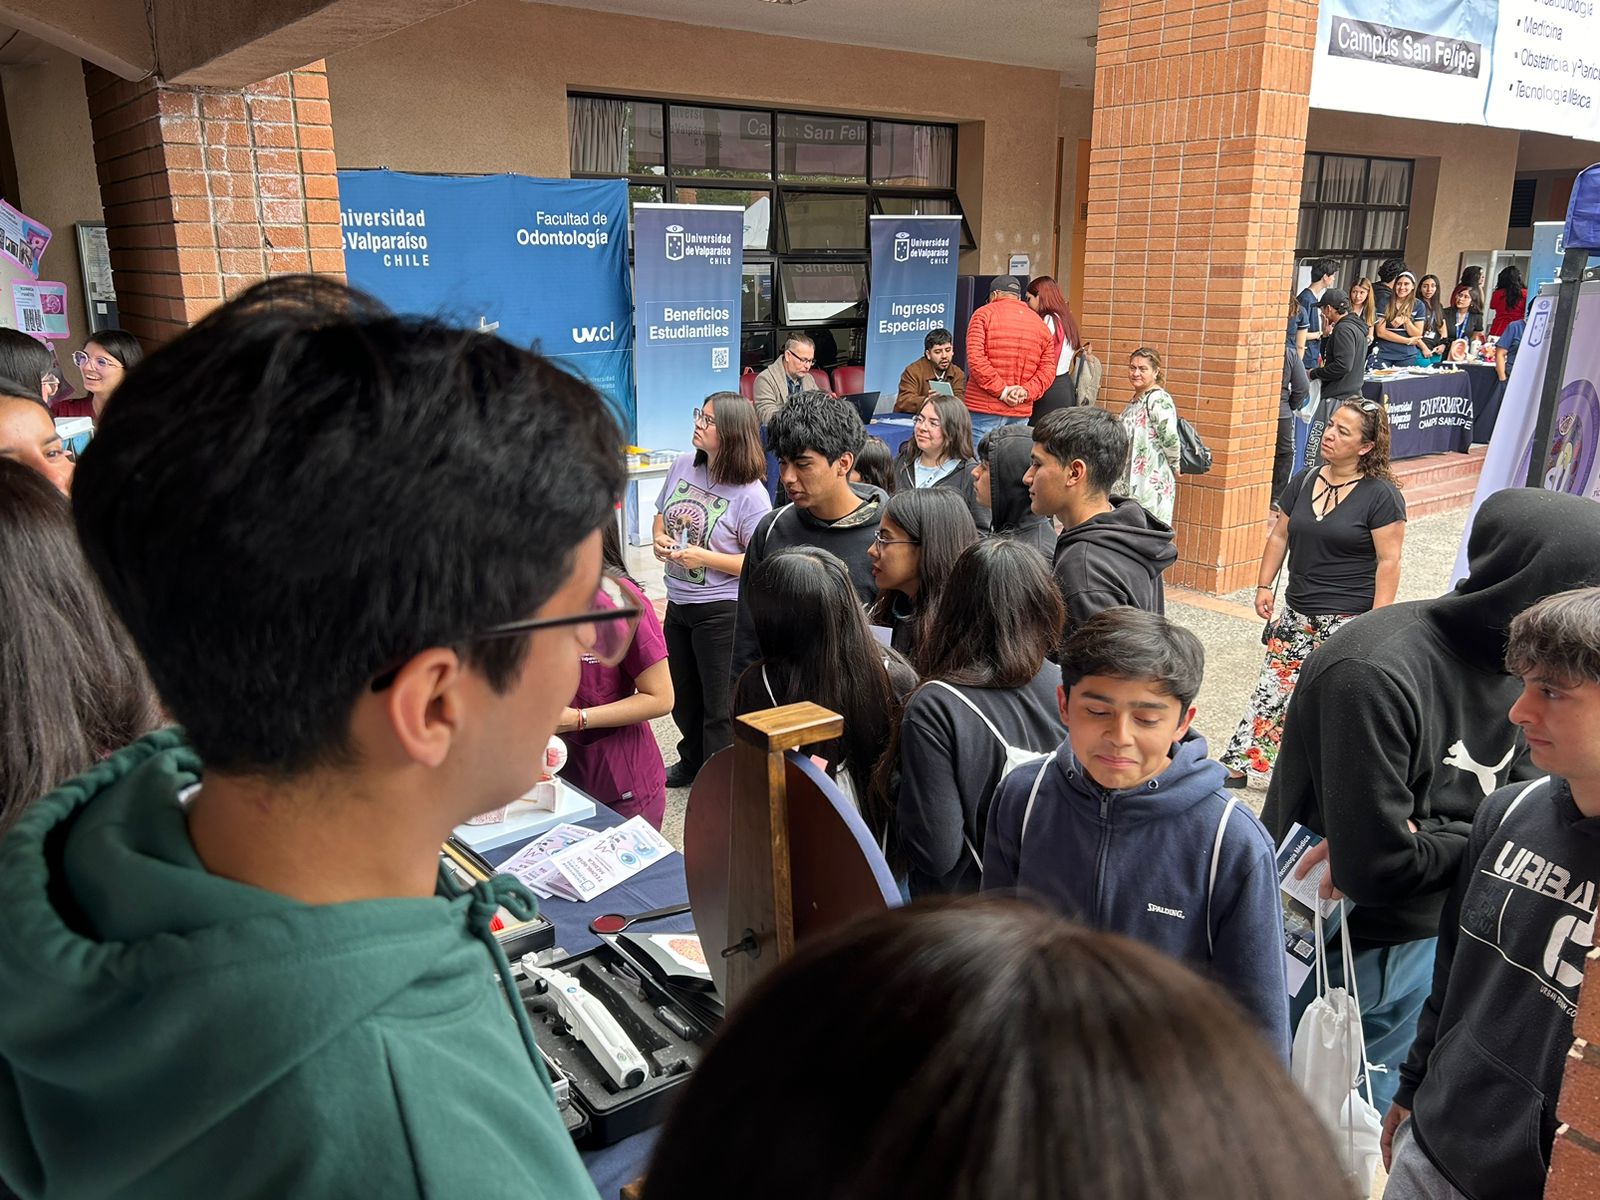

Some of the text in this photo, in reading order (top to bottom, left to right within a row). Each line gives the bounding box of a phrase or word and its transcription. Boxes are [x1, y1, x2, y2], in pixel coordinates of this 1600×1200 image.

[1524, 16, 1563, 41] Medicina
[1338, 23, 1476, 73] Campus San Felipe
[1520, 48, 1569, 72] Obstetricia
[803, 124, 835, 141] San
[340, 208, 426, 227] niversidad
[536, 211, 608, 226] Facultad de
[346, 231, 428, 254] Valparaíso
[516, 228, 609, 249] Odontología
[685, 232, 732, 244] Universidad
[910, 237, 950, 248] Universidad
[383, 254, 430, 267] CHILE
[709, 257, 732, 265] CHILE
[930, 257, 949, 265] CHILE
[664, 306, 730, 322] Beneficios
[891, 302, 945, 318] Ingresos
[572, 321, 615, 344] uv.cl
[649, 324, 730, 340] Estudiantiles
[879, 317, 944, 336] Especiales
